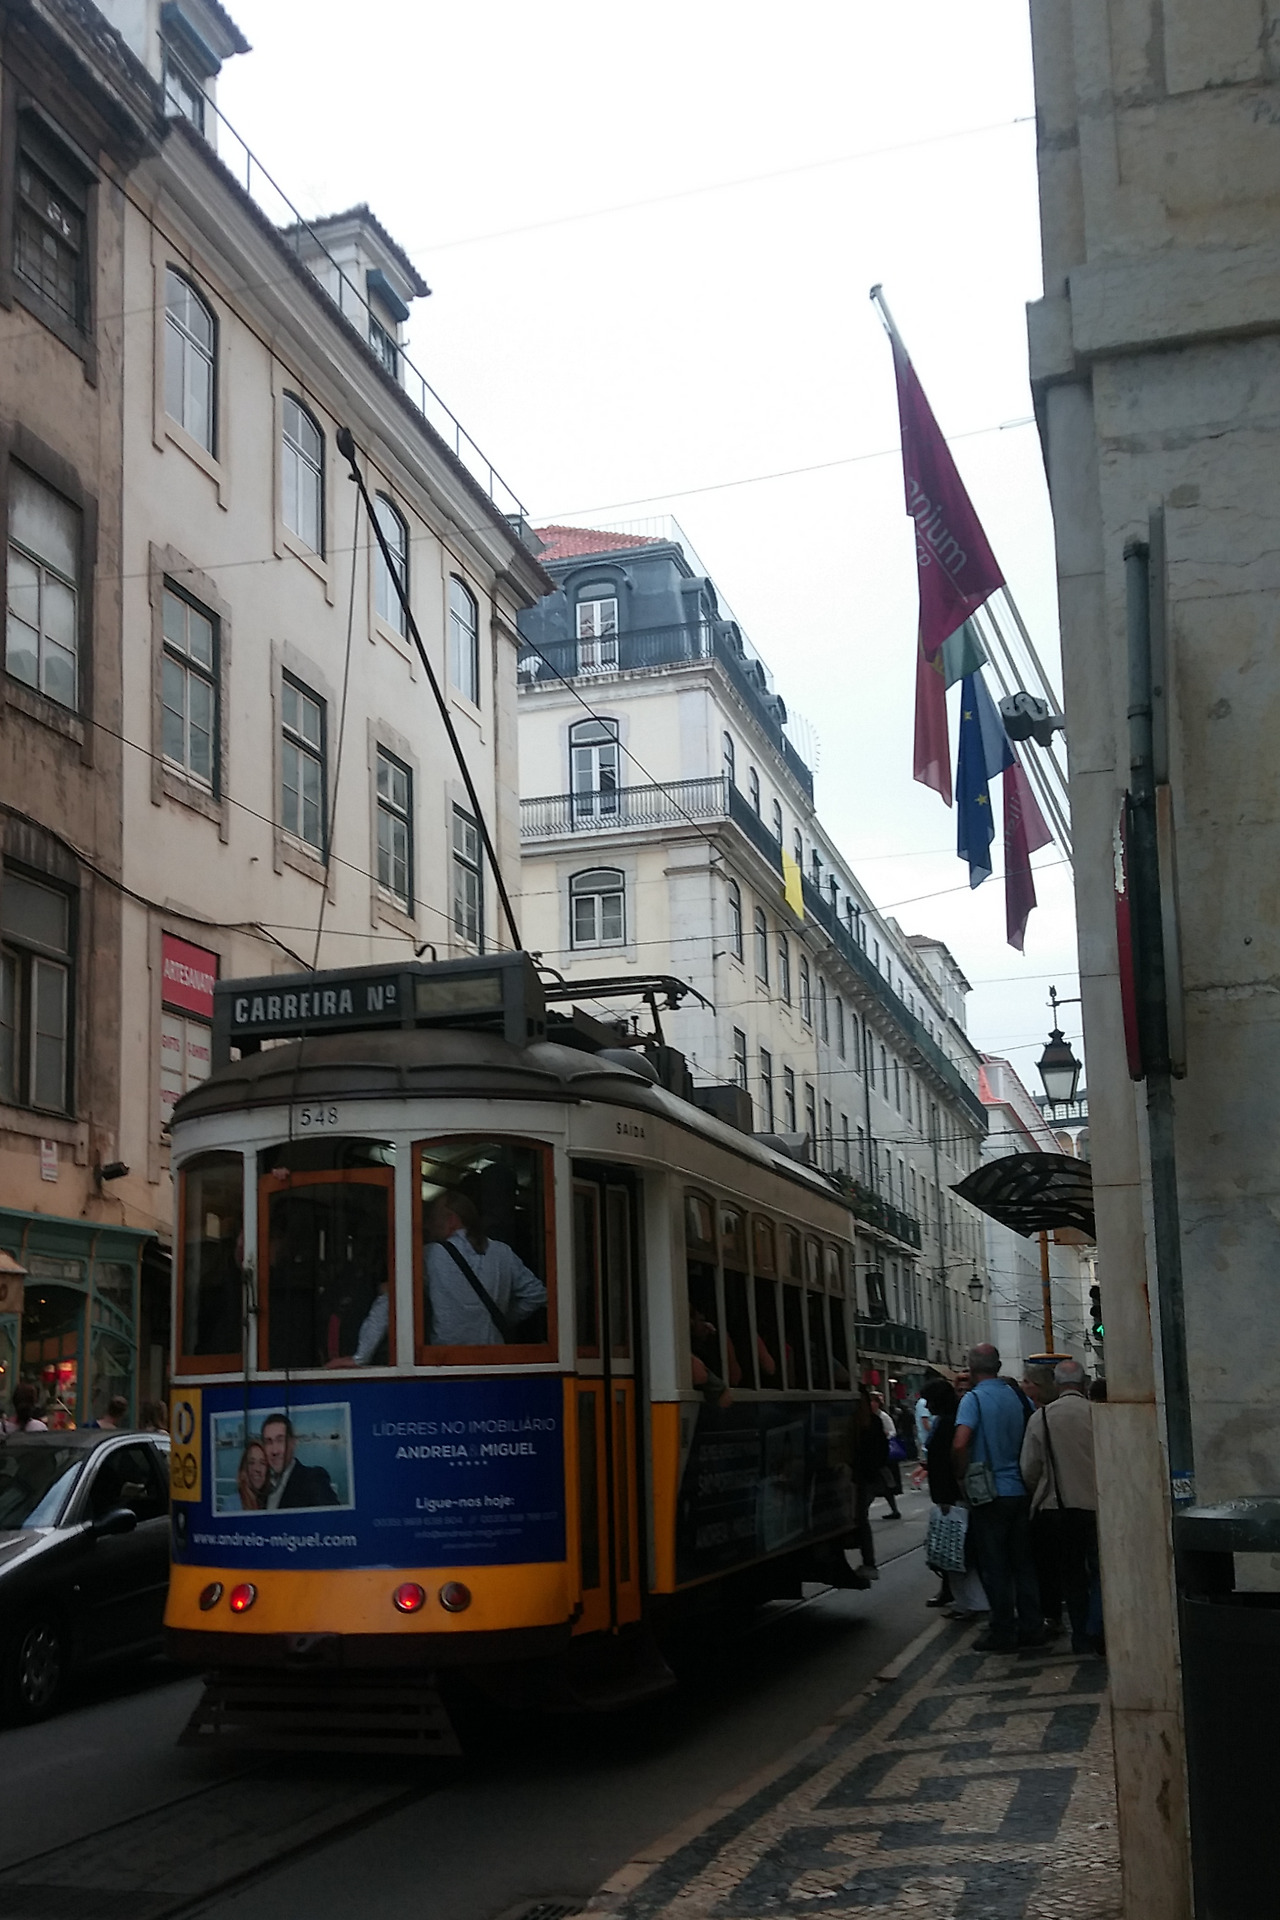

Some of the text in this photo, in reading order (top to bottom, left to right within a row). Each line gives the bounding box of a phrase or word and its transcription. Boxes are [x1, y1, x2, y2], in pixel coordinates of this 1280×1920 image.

[234, 989, 354, 1023] CARREIRA
[300, 1106, 339, 1126] 548
[372, 1416, 556, 1436] LÍDERES NO IMOBILIÁRIO
[395, 1444, 468, 1459] ANDREIA
[480, 1442, 537, 1457] MIGUEL
[416, 1495, 516, 1513] Ligue-nos hoje:
[193, 1532, 357, 1552] www.andreia-miguel.com
